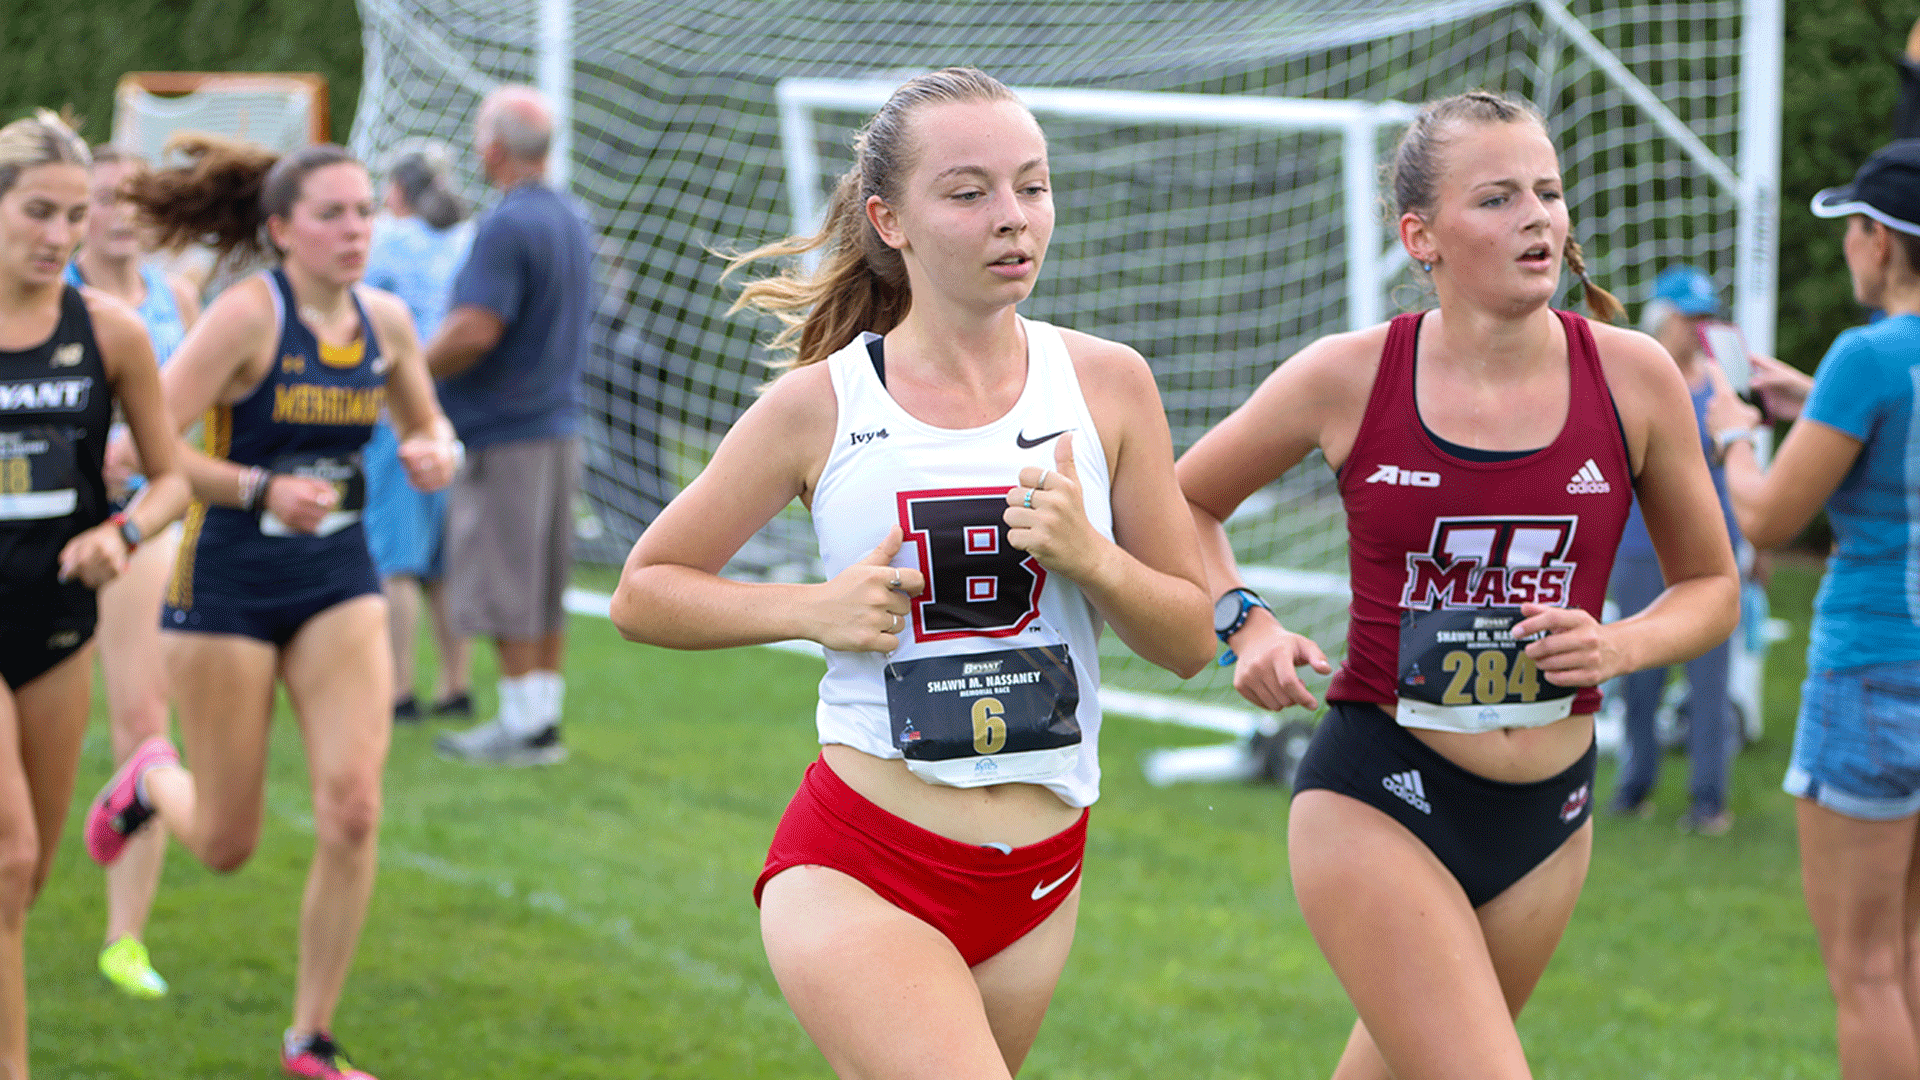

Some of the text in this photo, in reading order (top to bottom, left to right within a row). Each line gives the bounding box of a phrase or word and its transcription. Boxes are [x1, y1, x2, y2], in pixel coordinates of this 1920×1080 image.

[850, 431, 875, 446] Ivy
[1566, 480, 1611, 494] adidas
[896, 485, 1047, 642] B
[1437, 630, 1475, 643] SHAWN
[927, 671, 1041, 693] SHAWN M. NASSANEY
[1442, 650, 1541, 704] 284
[960, 686, 1010, 697] MEMORIAL RACE
[971, 697, 1007, 755] 6
